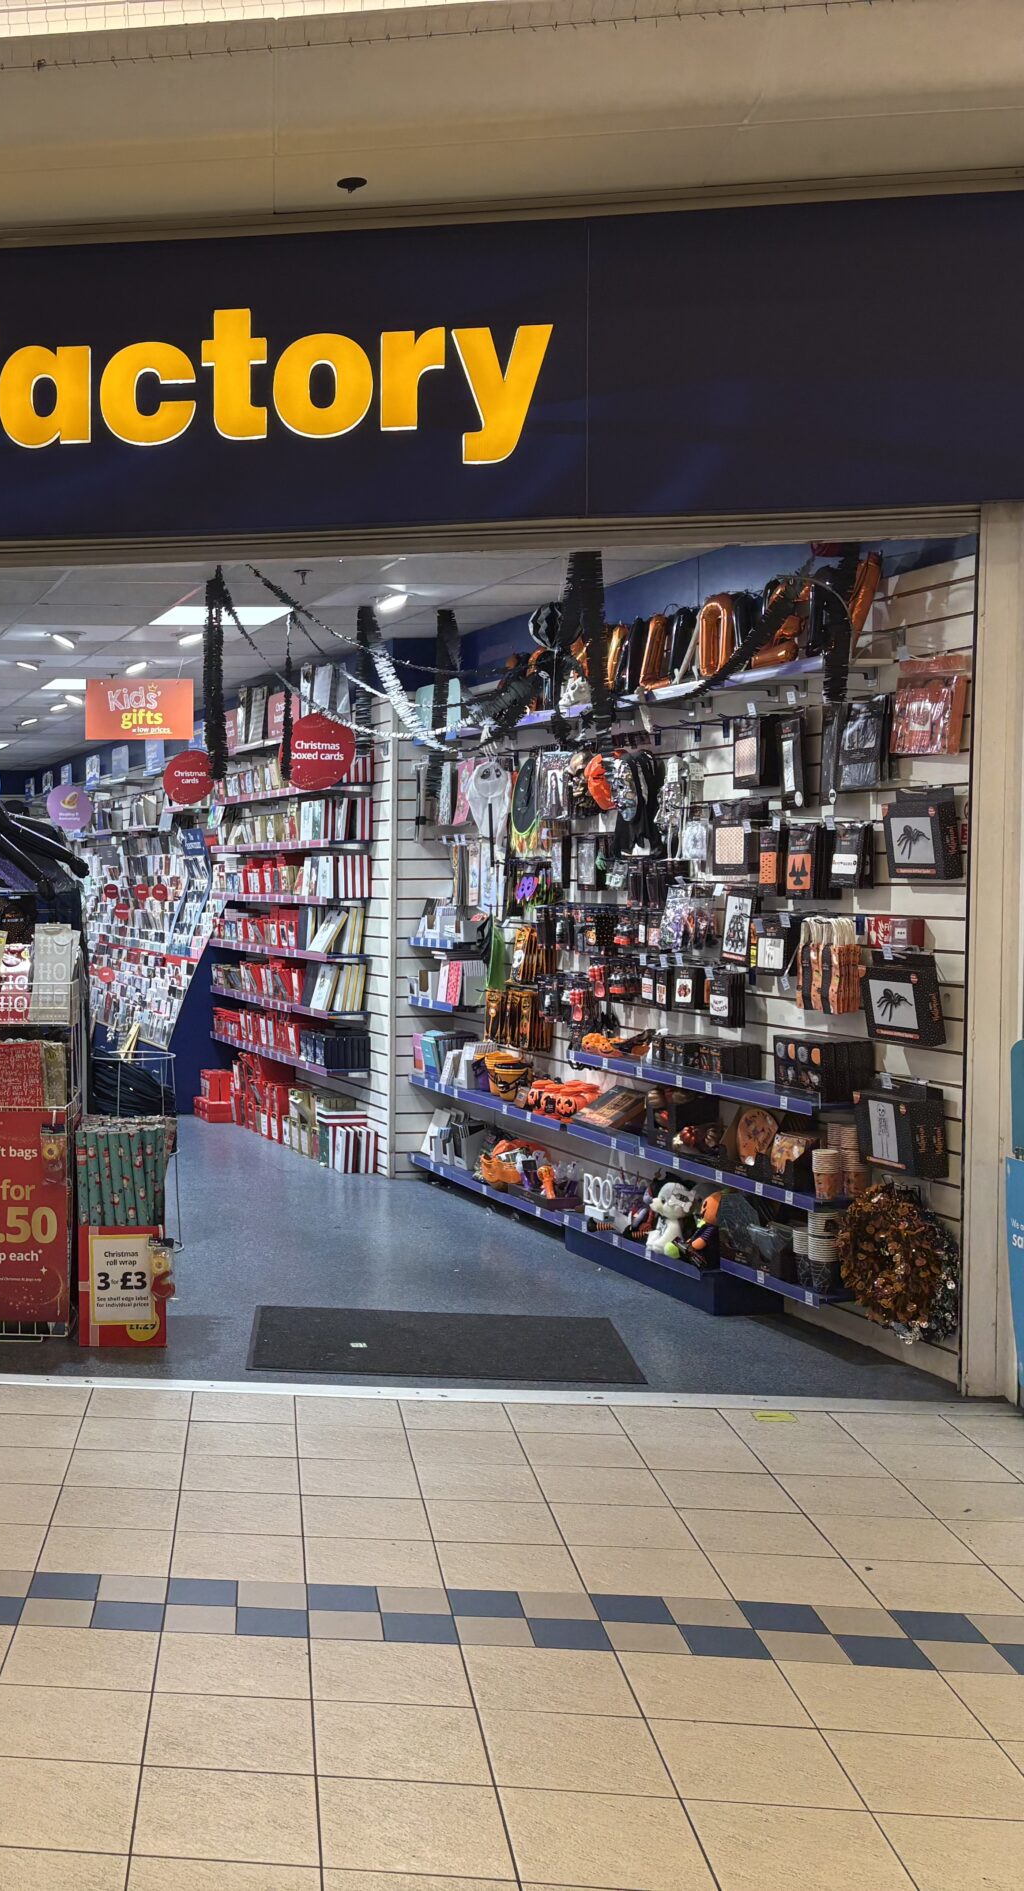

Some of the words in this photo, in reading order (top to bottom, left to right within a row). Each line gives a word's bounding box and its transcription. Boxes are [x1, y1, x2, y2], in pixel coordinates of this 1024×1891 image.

[121, 709, 164, 730] gifts
[150, 727, 171, 735] prices
[295, 740, 340, 750] Christmas
[320, 751, 344, 761] cards
[38, 963, 67, 981] HO
[1, 974, 28, 991] HO
[0, 995, 28, 1013] HO
[9, 1146, 38, 1160] bags
[0, 1179, 36, 1200] for
[584, 1173, 612, 1209] BOO
[97, 1272, 111, 1290] 3
[120, 1271, 147, 1290] £3
